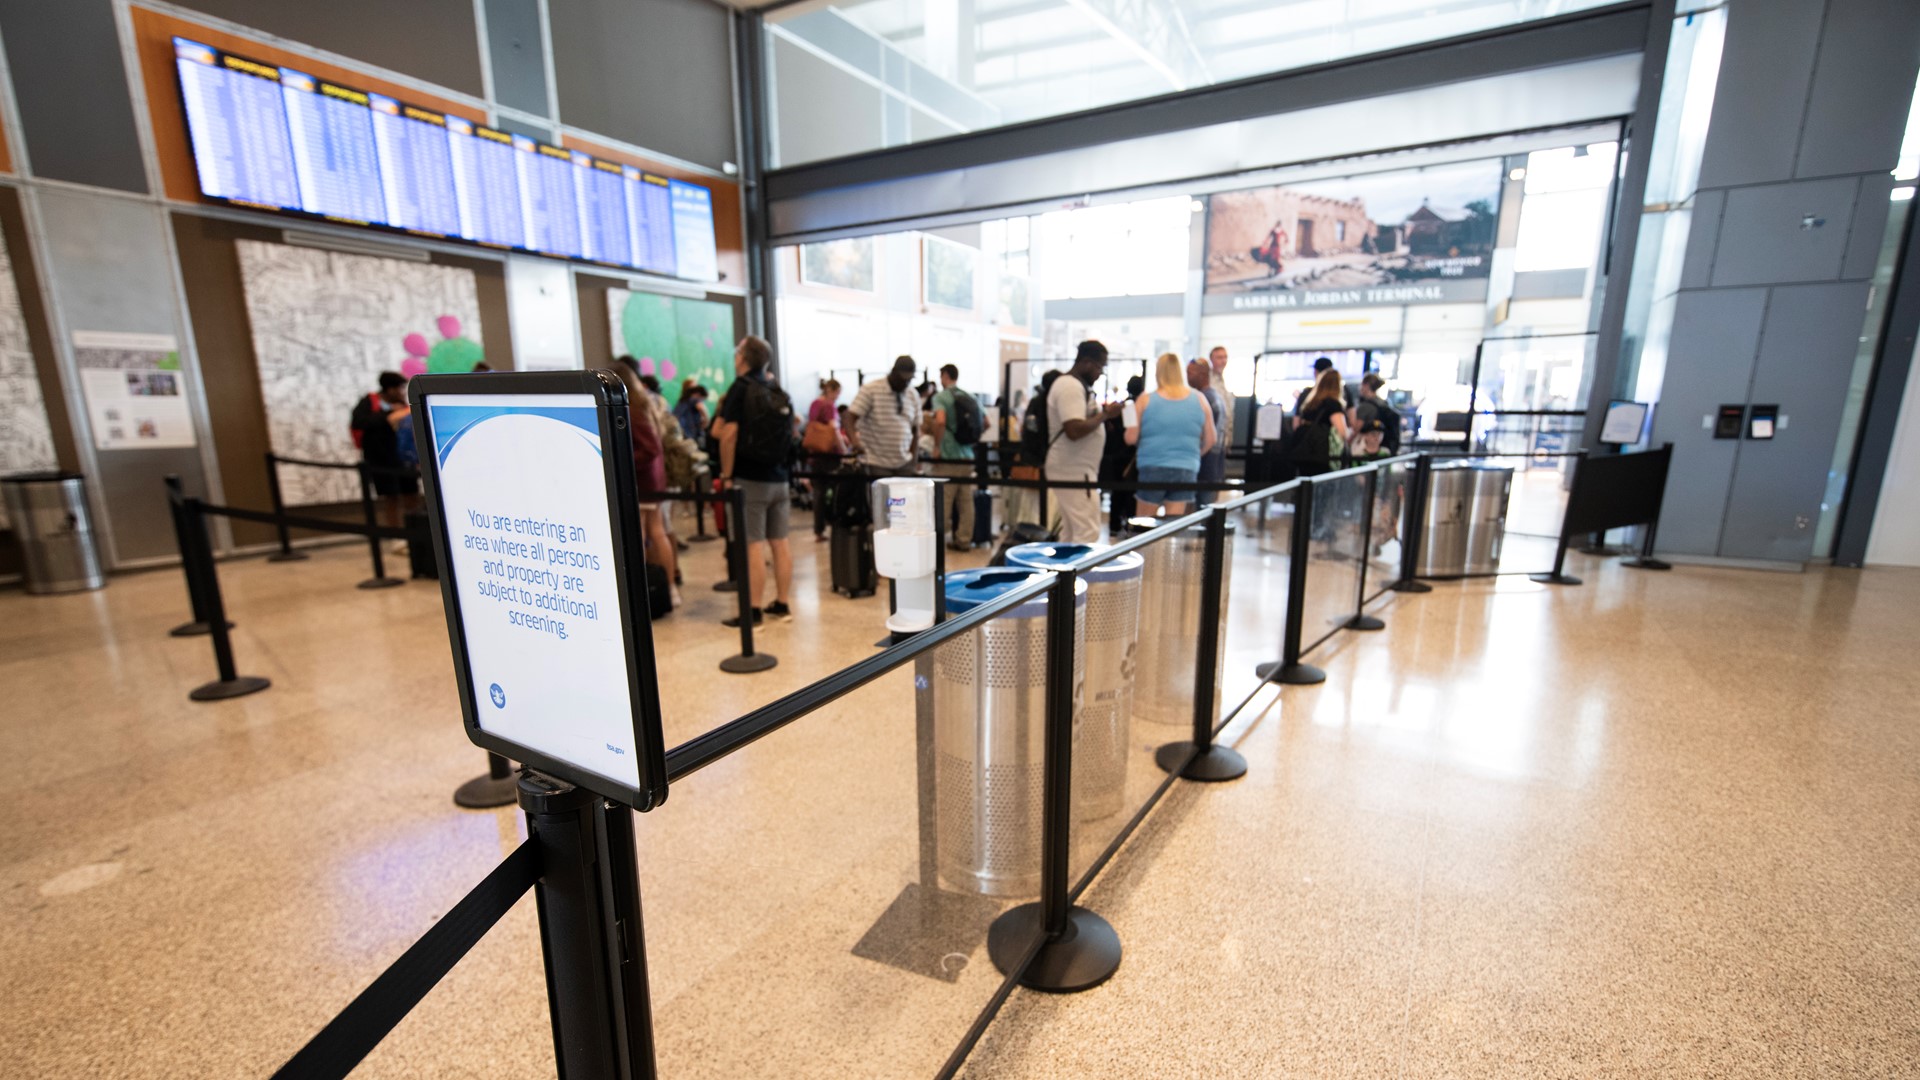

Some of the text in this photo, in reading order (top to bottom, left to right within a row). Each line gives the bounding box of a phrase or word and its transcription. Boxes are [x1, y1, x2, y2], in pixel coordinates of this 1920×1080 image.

[1304, 290, 1361, 306] JORDAN
[1367, 286, 1444, 303] TERMINAL
[468, 509, 586, 543] You are entering an
[464, 534, 600, 571] area where all persons
[483, 560, 584, 593] and property are
[478, 580, 598, 621] subject to additional
[509, 610, 569, 640] screening.
[606, 742, 625, 755] tsa.gov
